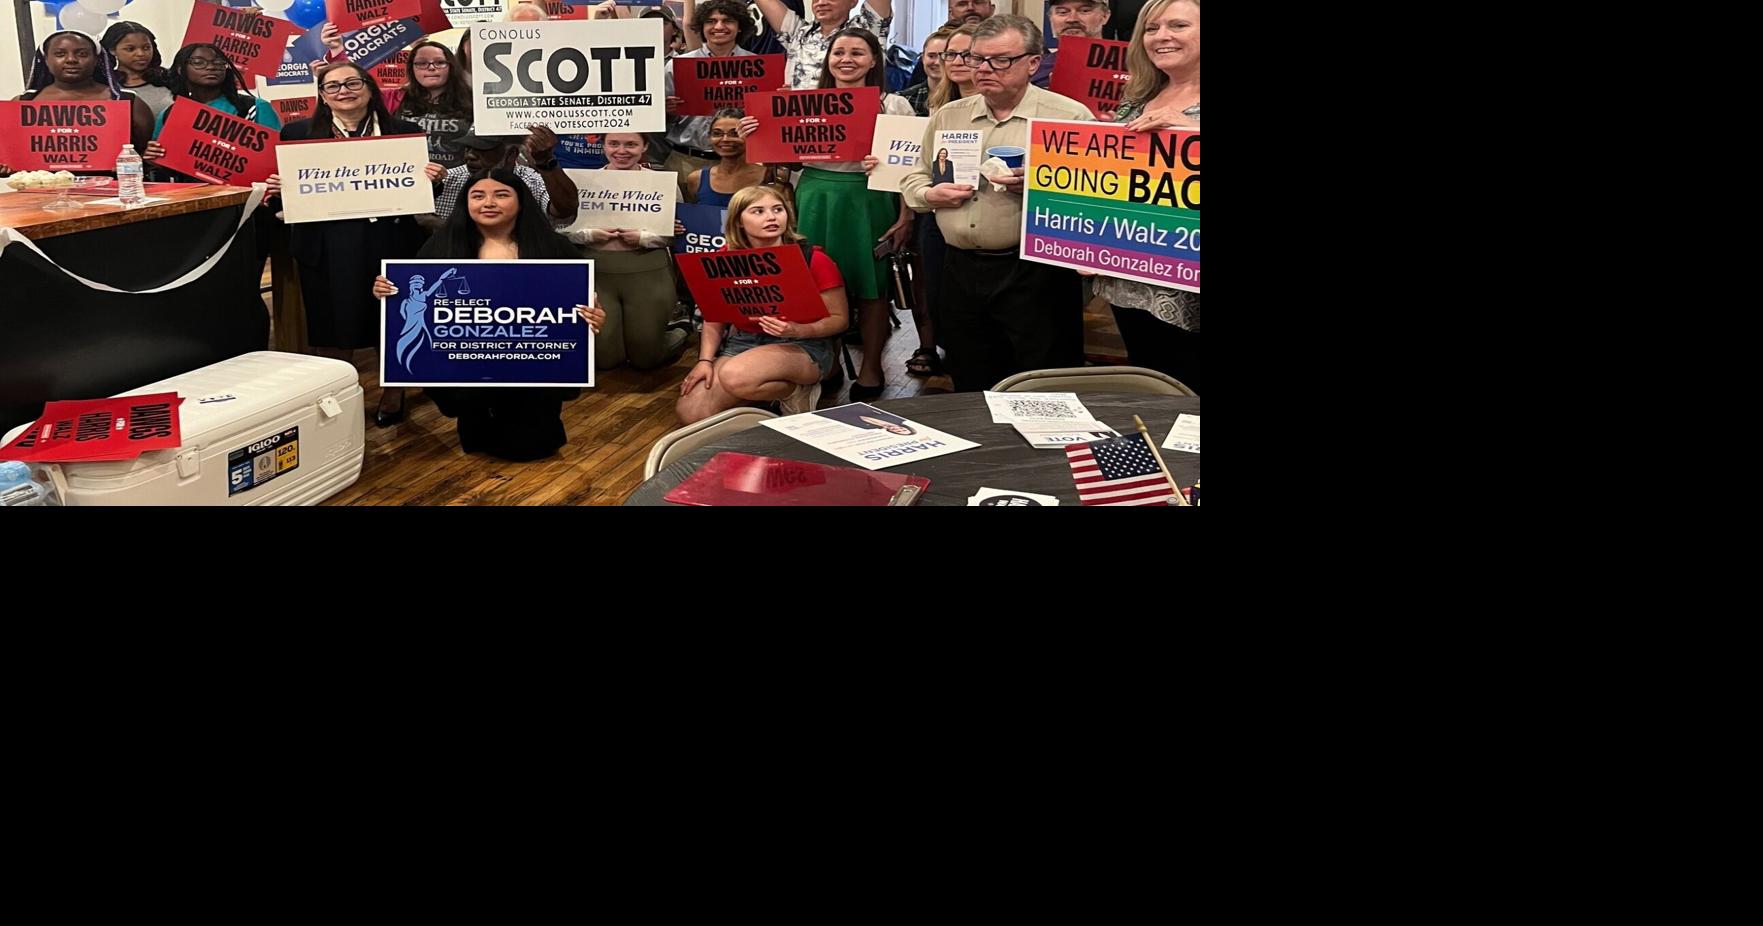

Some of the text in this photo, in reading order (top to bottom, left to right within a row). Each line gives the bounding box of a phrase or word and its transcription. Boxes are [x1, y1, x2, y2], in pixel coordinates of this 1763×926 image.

[212, 9, 274, 38] DAWGS
[356, 7, 389, 22] WALZ
[347, 24, 407, 63] MOCRATS
[479, 28, 541, 41] CONOLUS
[213, 34, 261, 59] HARRIS
[278, 63, 309, 71] ORGIA
[377, 67, 406, 78] HARRIS
[483, 42, 656, 95] SCOTT
[696, 58, 765, 80] DAWGS
[280, 99, 309, 113] DAWGS
[487, 95, 651, 107] GEORGIA STATE SENATE, DISTRICT 47
[772, 92, 854, 118] DAWGS
[21, 105, 107, 127] DAWGS
[506, 109, 633, 119] WWW.CONOLUSSCOTT.COM
[554, 118, 630, 129] VOTESCOTT2024
[192, 108, 269, 153] DAWGS
[781, 124, 847, 144] HARRIS
[31, 135, 98, 152] HARRIS
[217, 140, 231, 149] FOR
[793, 144, 836, 155] WALZ
[888, 140, 921, 153] Win
[1042, 130, 1200, 172] WE ARE NO
[43, 154, 89, 164] WALZ
[188, 139, 249, 174] HARRIS
[193, 160, 232, 181] WALZ
[297, 162, 415, 181] Win the Whole
[299, 176, 415, 195] DEM THING
[597, 189, 620, 200] the
[622, 190, 664, 201] Whole
[1036, 164, 1200, 211] GOING BAC
[580, 201, 662, 213] EM THING
[1035, 206, 1095, 236] Harris
[1113, 217, 1168, 247] Walz
[1174, 226, 1200, 251] 20
[686, 233, 726, 247] GEO
[701, 252, 782, 279] DAWGS
[1034, 238, 1095, 262] Deborah
[1098, 249, 1173, 278] Gonzalez
[433, 298, 492, 306] RE-ELECT
[721, 285, 785, 305] HARRIS
[433, 307, 578, 324] DEBORAH
[739, 305, 780, 316] WALZ
[433, 325, 549, 338] GONZALEZ
[432, 342, 577, 350] FOR DISTRICT ATTORNEY
[53, 419, 74, 440] WALZ
[75, 411, 113, 442] HARRIS
[128, 403, 173, 440] DAWGS
[248, 435, 281, 454] IGLOO
[278, 445, 293, 457] 120
[864, 440, 947, 461] HARRIS
[231, 468, 243, 485] 5
